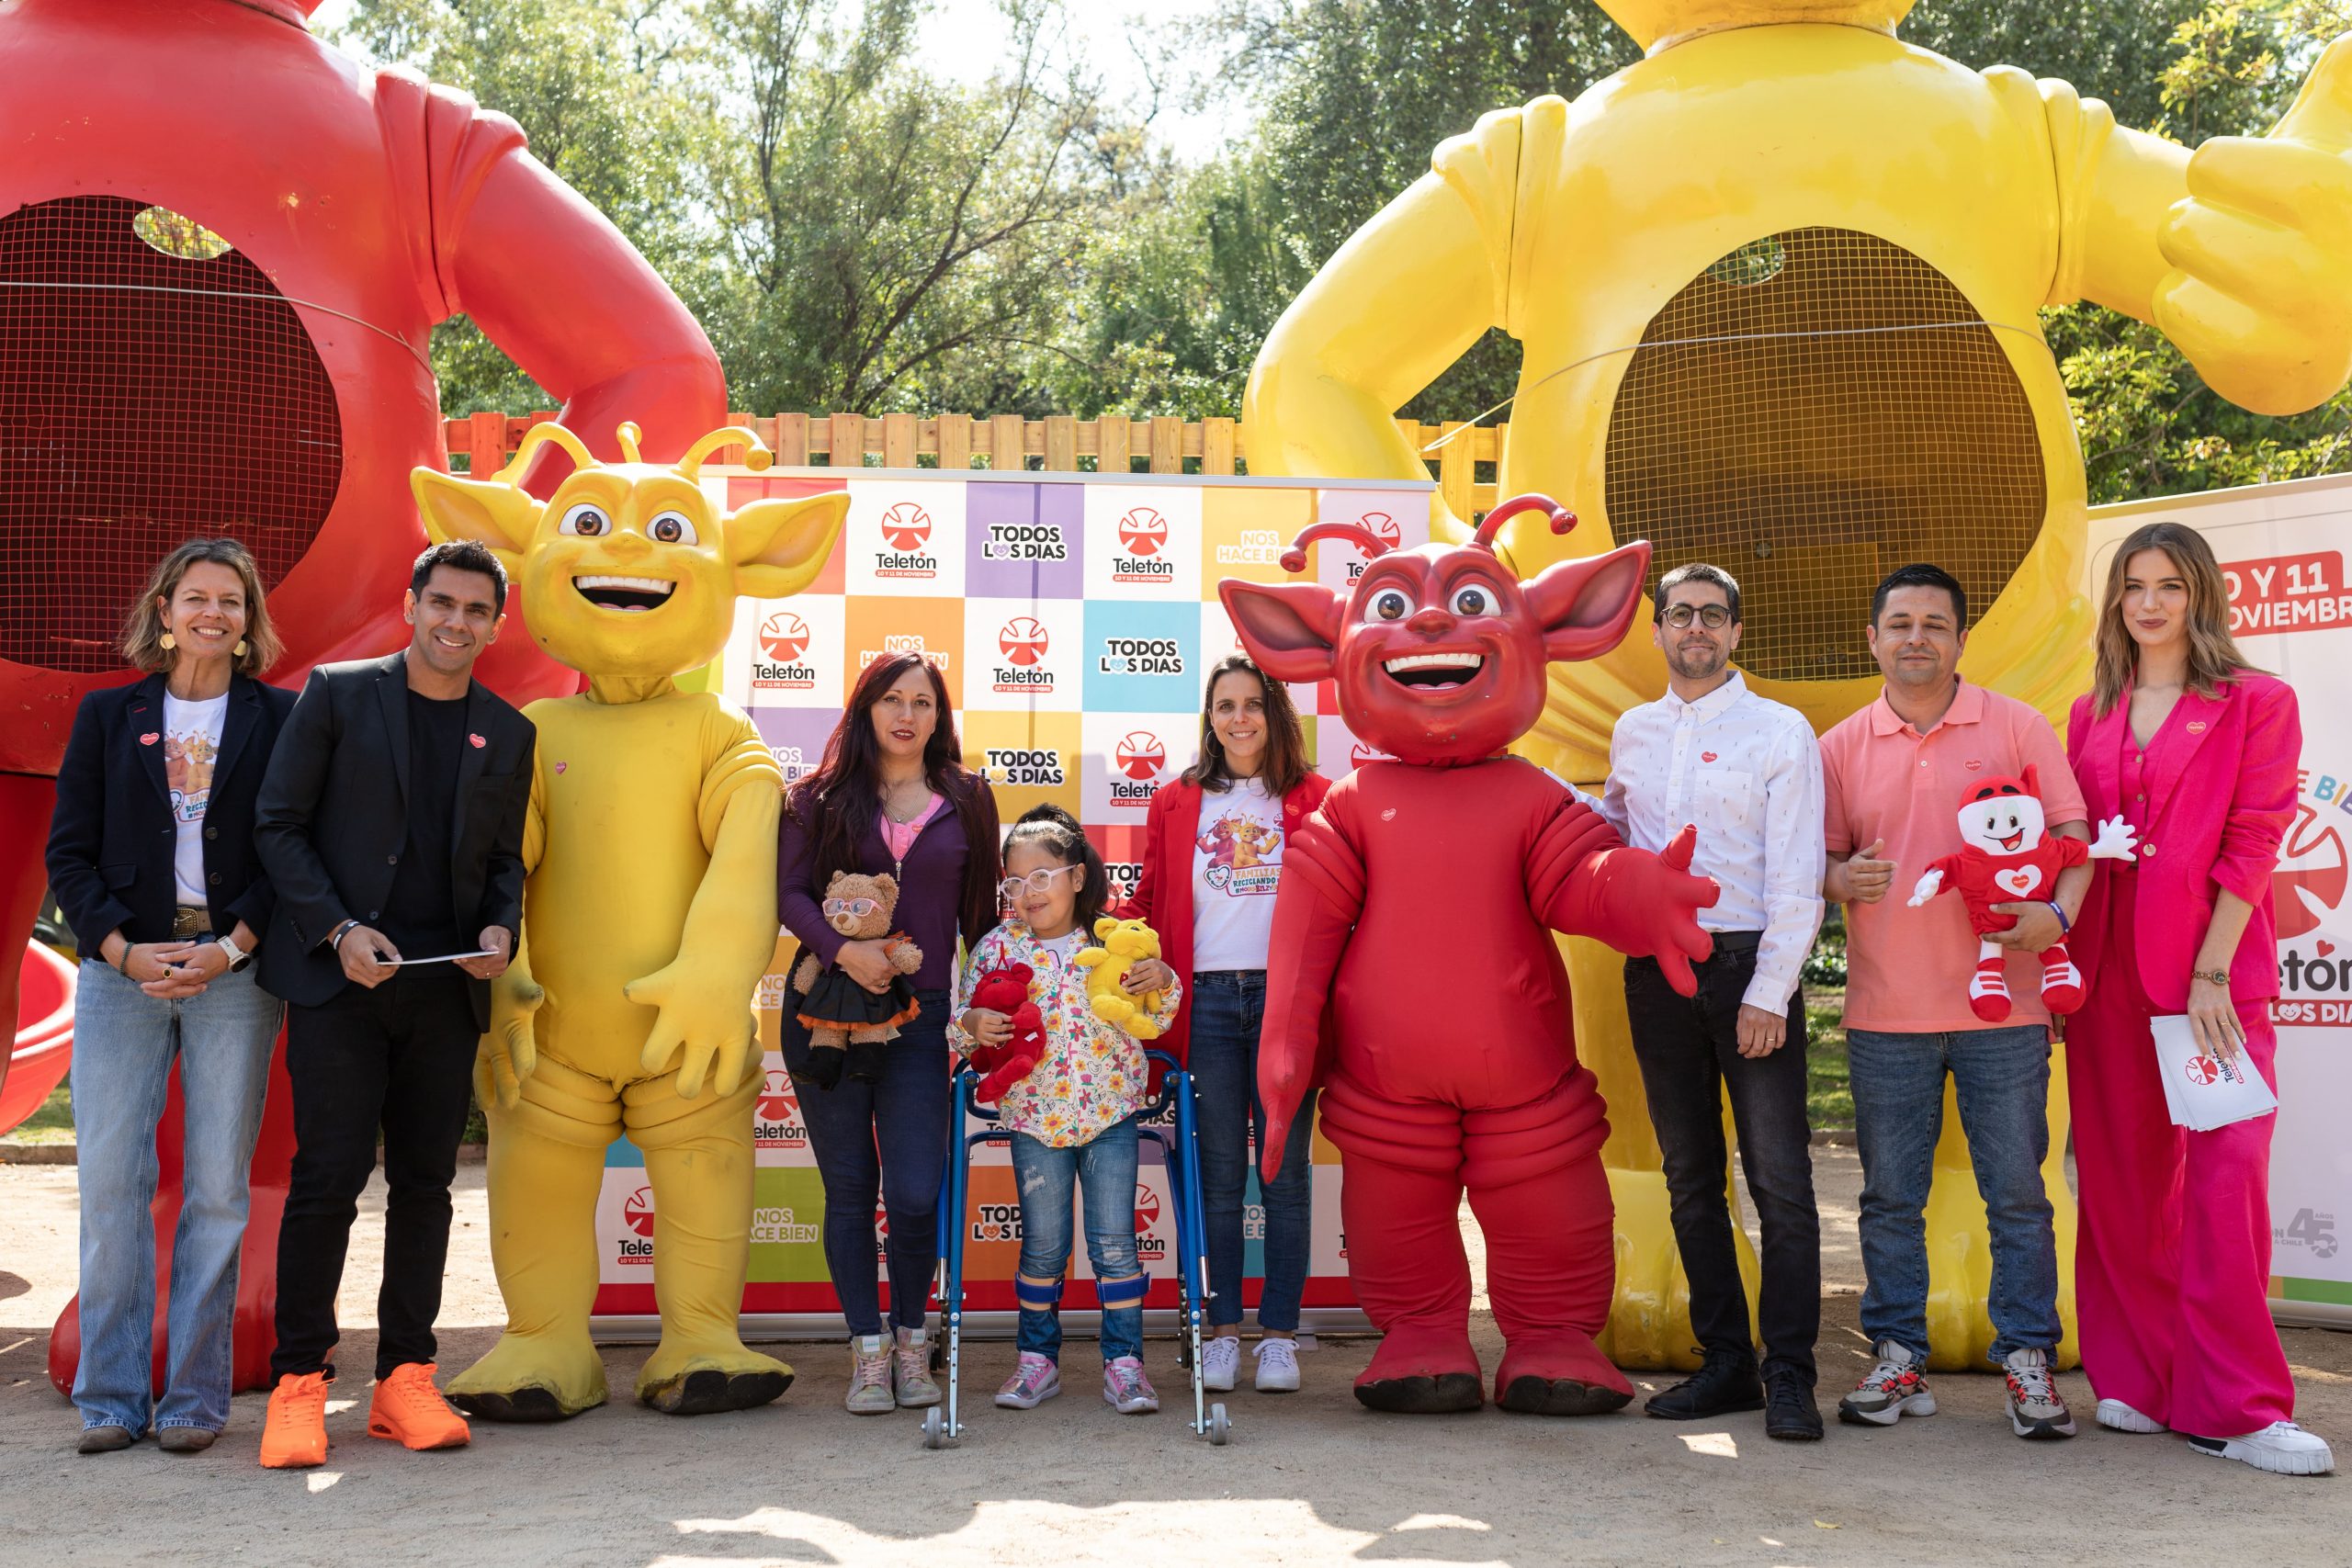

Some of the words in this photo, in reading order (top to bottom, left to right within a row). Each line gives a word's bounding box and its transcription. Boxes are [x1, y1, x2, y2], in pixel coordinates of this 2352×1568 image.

[990, 525, 1060, 543] TODOS
[1243, 533, 1277, 546] NOS
[1024, 544, 1066, 559] DIAS
[1219, 548, 1261, 561] HACE
[2250, 565, 2277, 598] Y
[2286, 561, 2329, 596] 11
[2229, 595, 2352, 632] OVIEMBR
[888, 637, 922, 651] NOS
[1107, 640, 1177, 657] TODOS
[1141, 658, 1182, 673] DIAS
[987, 750, 1057, 768] TODOS
[1022, 768, 1063, 784] DIAS
[753, 1120, 807, 1139] eletón
[756, 1210, 791, 1224] NOS
[980, 1205, 1022, 1223] TOD
[779, 1226, 816, 1240] BIEN
[617, 1238, 653, 1255] Tele
